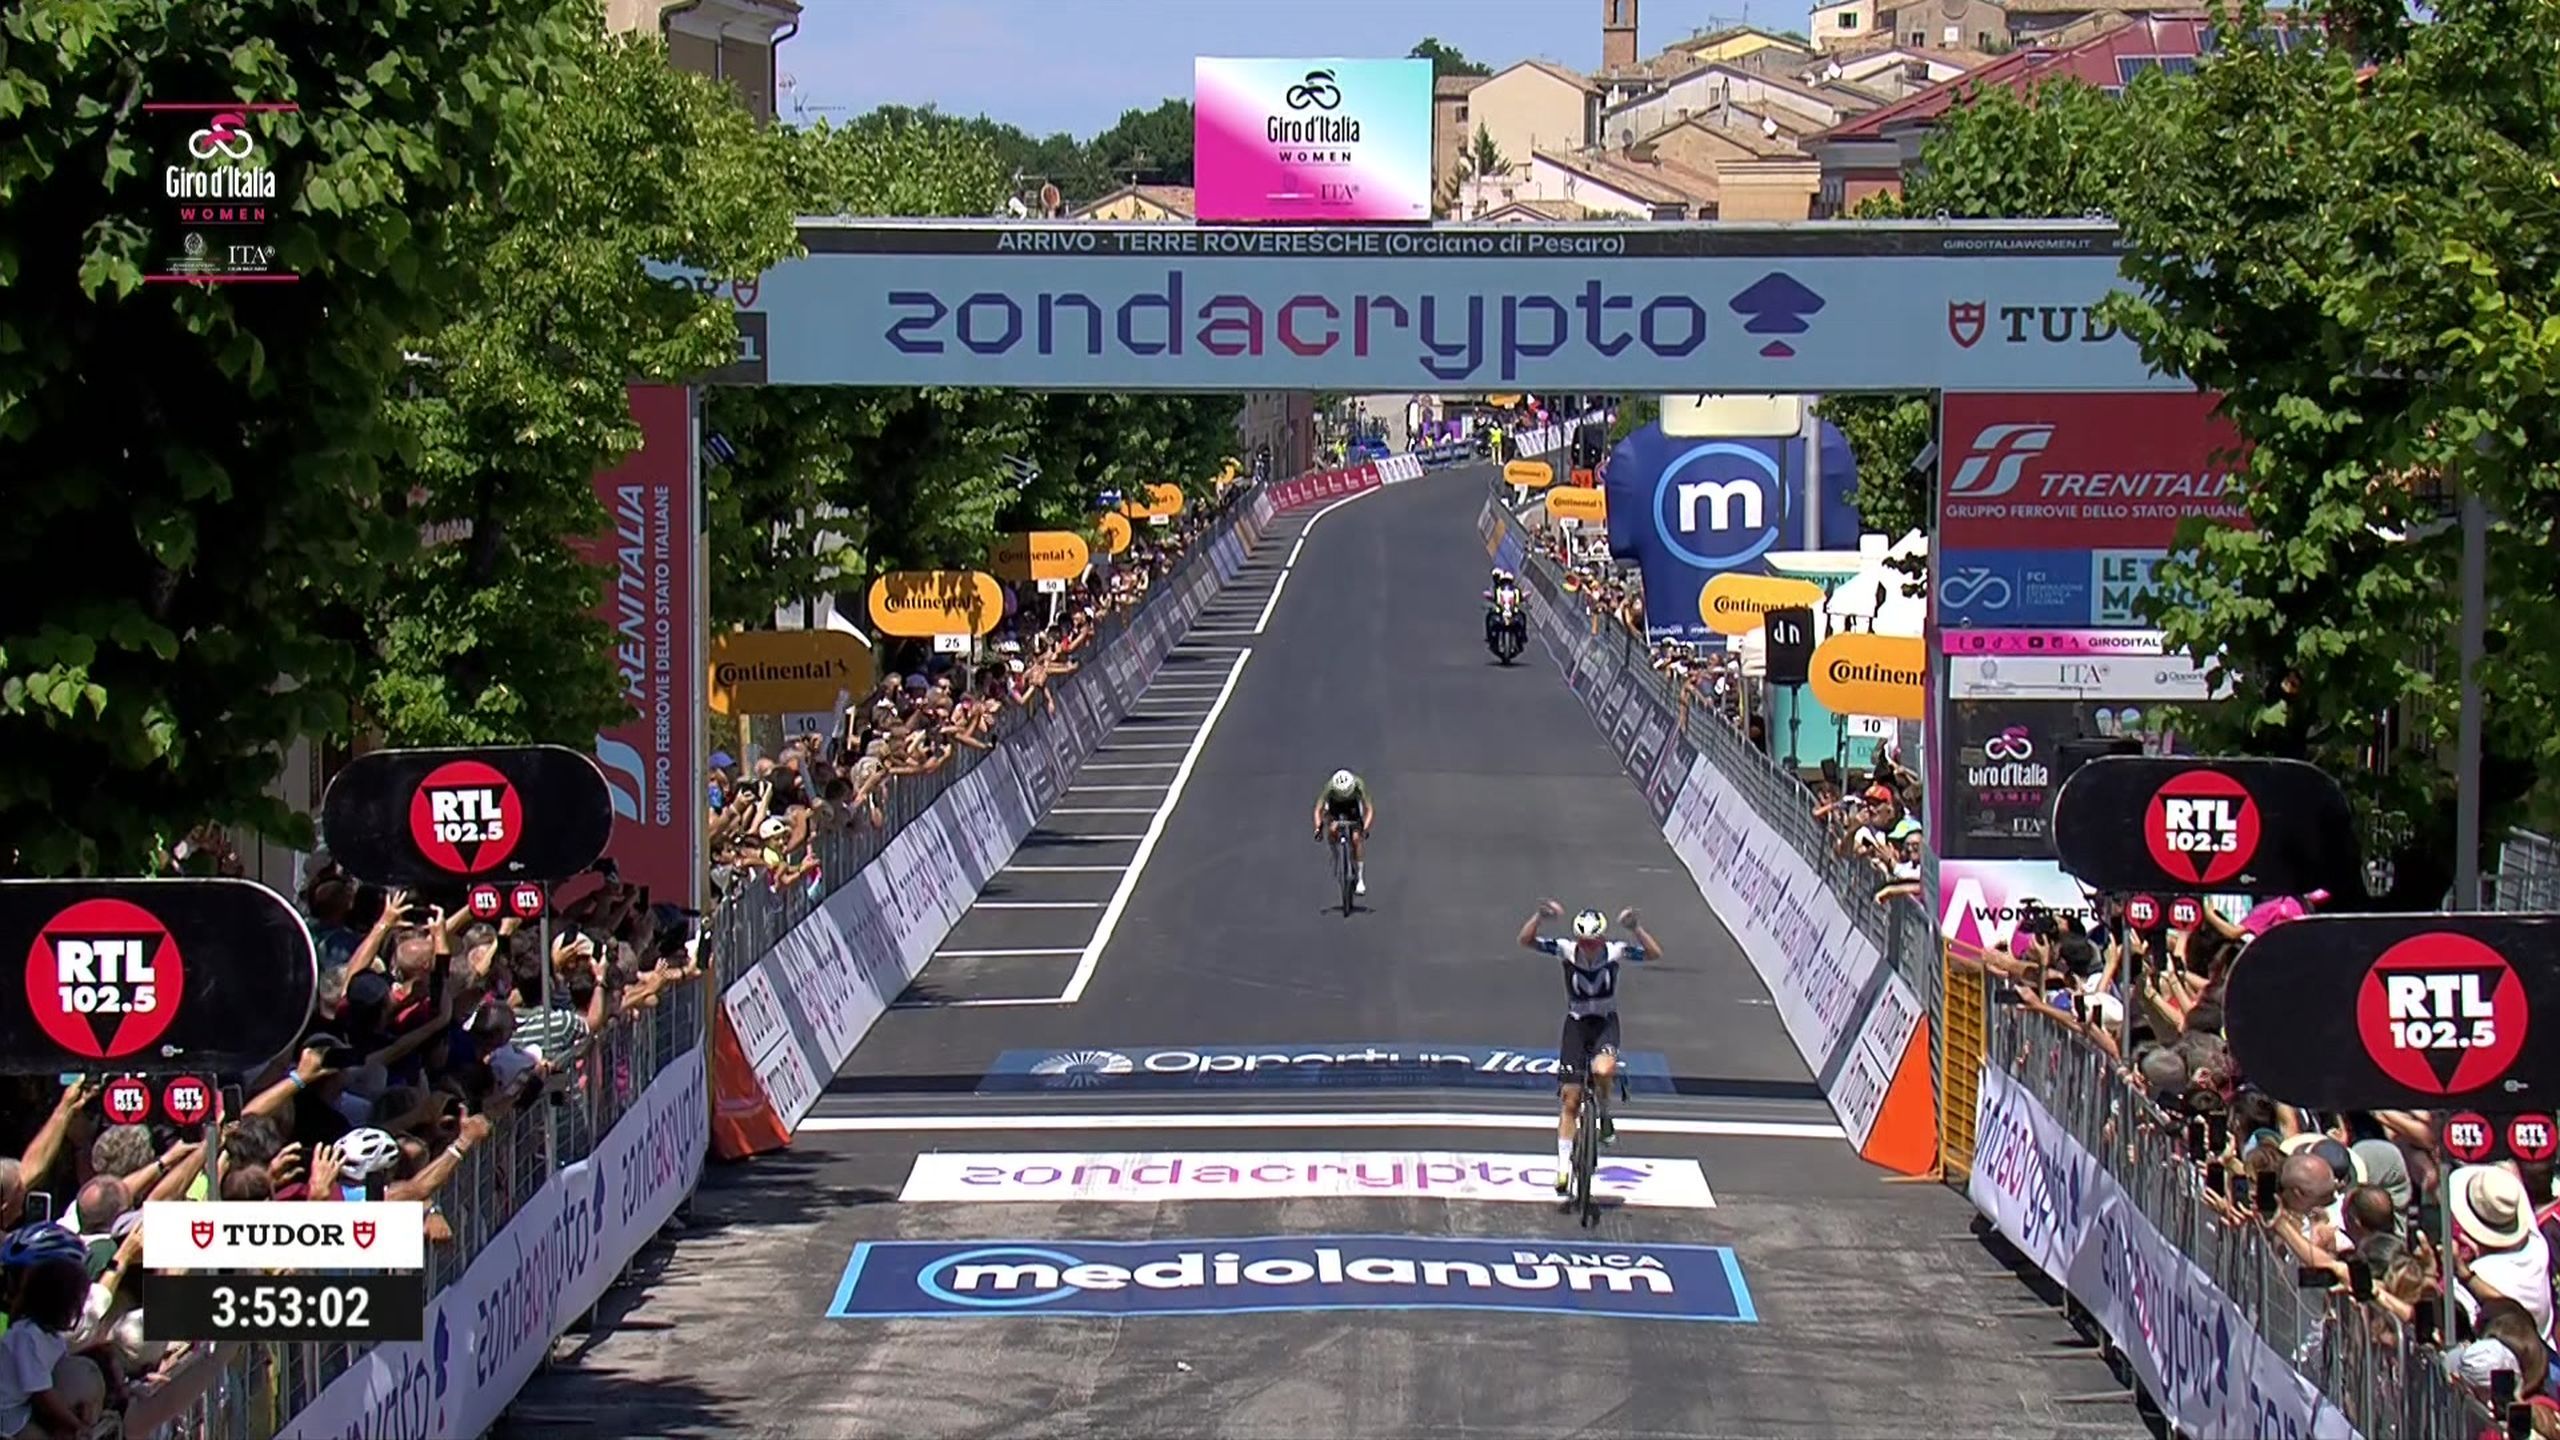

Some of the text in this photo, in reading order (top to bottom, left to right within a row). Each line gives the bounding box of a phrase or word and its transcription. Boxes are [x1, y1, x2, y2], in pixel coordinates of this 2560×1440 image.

[1267, 116, 1360, 142] Giro d'Italia
[1279, 152, 1351, 161] WOMEN
[997, 233, 1096, 252] ARRIVO
[1117, 233, 1198, 253] TERRE
[1204, 233, 1380, 253] ROVERESCHE
[1385, 231, 1493, 254] (Orciano
[1500, 232, 1523, 252] di
[1529, 231, 1626, 254] Pesaro)
[1943, 239, 2091, 249] GIRODITALIAWOMEN.IT
[886, 270, 1706, 380] zondacrypto
[1946, 505, 2006, 518] GRUPPO
[2011, 505, 2077, 518] FERROVIE
[2083, 505, 2127, 518] DELLO
[2132, 505, 2176, 518] STATO
[1046, 581, 1057, 590] 50
[2027, 572, 2046, 582] FCI
[618, 484, 645, 718] RENITALIA
[885, 594, 970, 613] Continental
[1714, 595, 1808, 614] Contine
[2089, 637, 2160, 648] GIRODITAL
[655, 485, 671, 826] GRUPPO FERROVIE DELLO STATO ITALIANE
[716, 659, 831, 687] Continental
[1829, 659, 1926, 687] Continent
[799, 716, 817, 732] 10
[1863, 718, 1881, 734] 10
[432, 789, 501, 822] RTL
[2166, 799, 2238, 831] RTL
[434, 823, 504, 843] 102.5
[2166, 833, 2238, 852] 102.5
[57, 940, 155, 984] RTL
[59, 986, 156, 1013] 102.5
[2388, 975, 2494, 1018] RTL
[2391, 1021, 2495, 1049] 102.5
[1477, 1050, 1562, 1075] Ita
[113, 1088, 143, 1102] RTL
[173, 1087, 203, 1101] RTL
[2451, 1123, 2482, 1138] RTL
[2515, 1123, 2547, 1138] RTL
[960, 1156, 1561, 1190] zondacrypto
[1976, 1097, 2067, 1248] ndacrypto
[952, 1247, 1674, 1293] mediolanum
[1513, 1250, 1664, 1270] BANCA
[476, 1189, 588, 1388] zondacrypto
